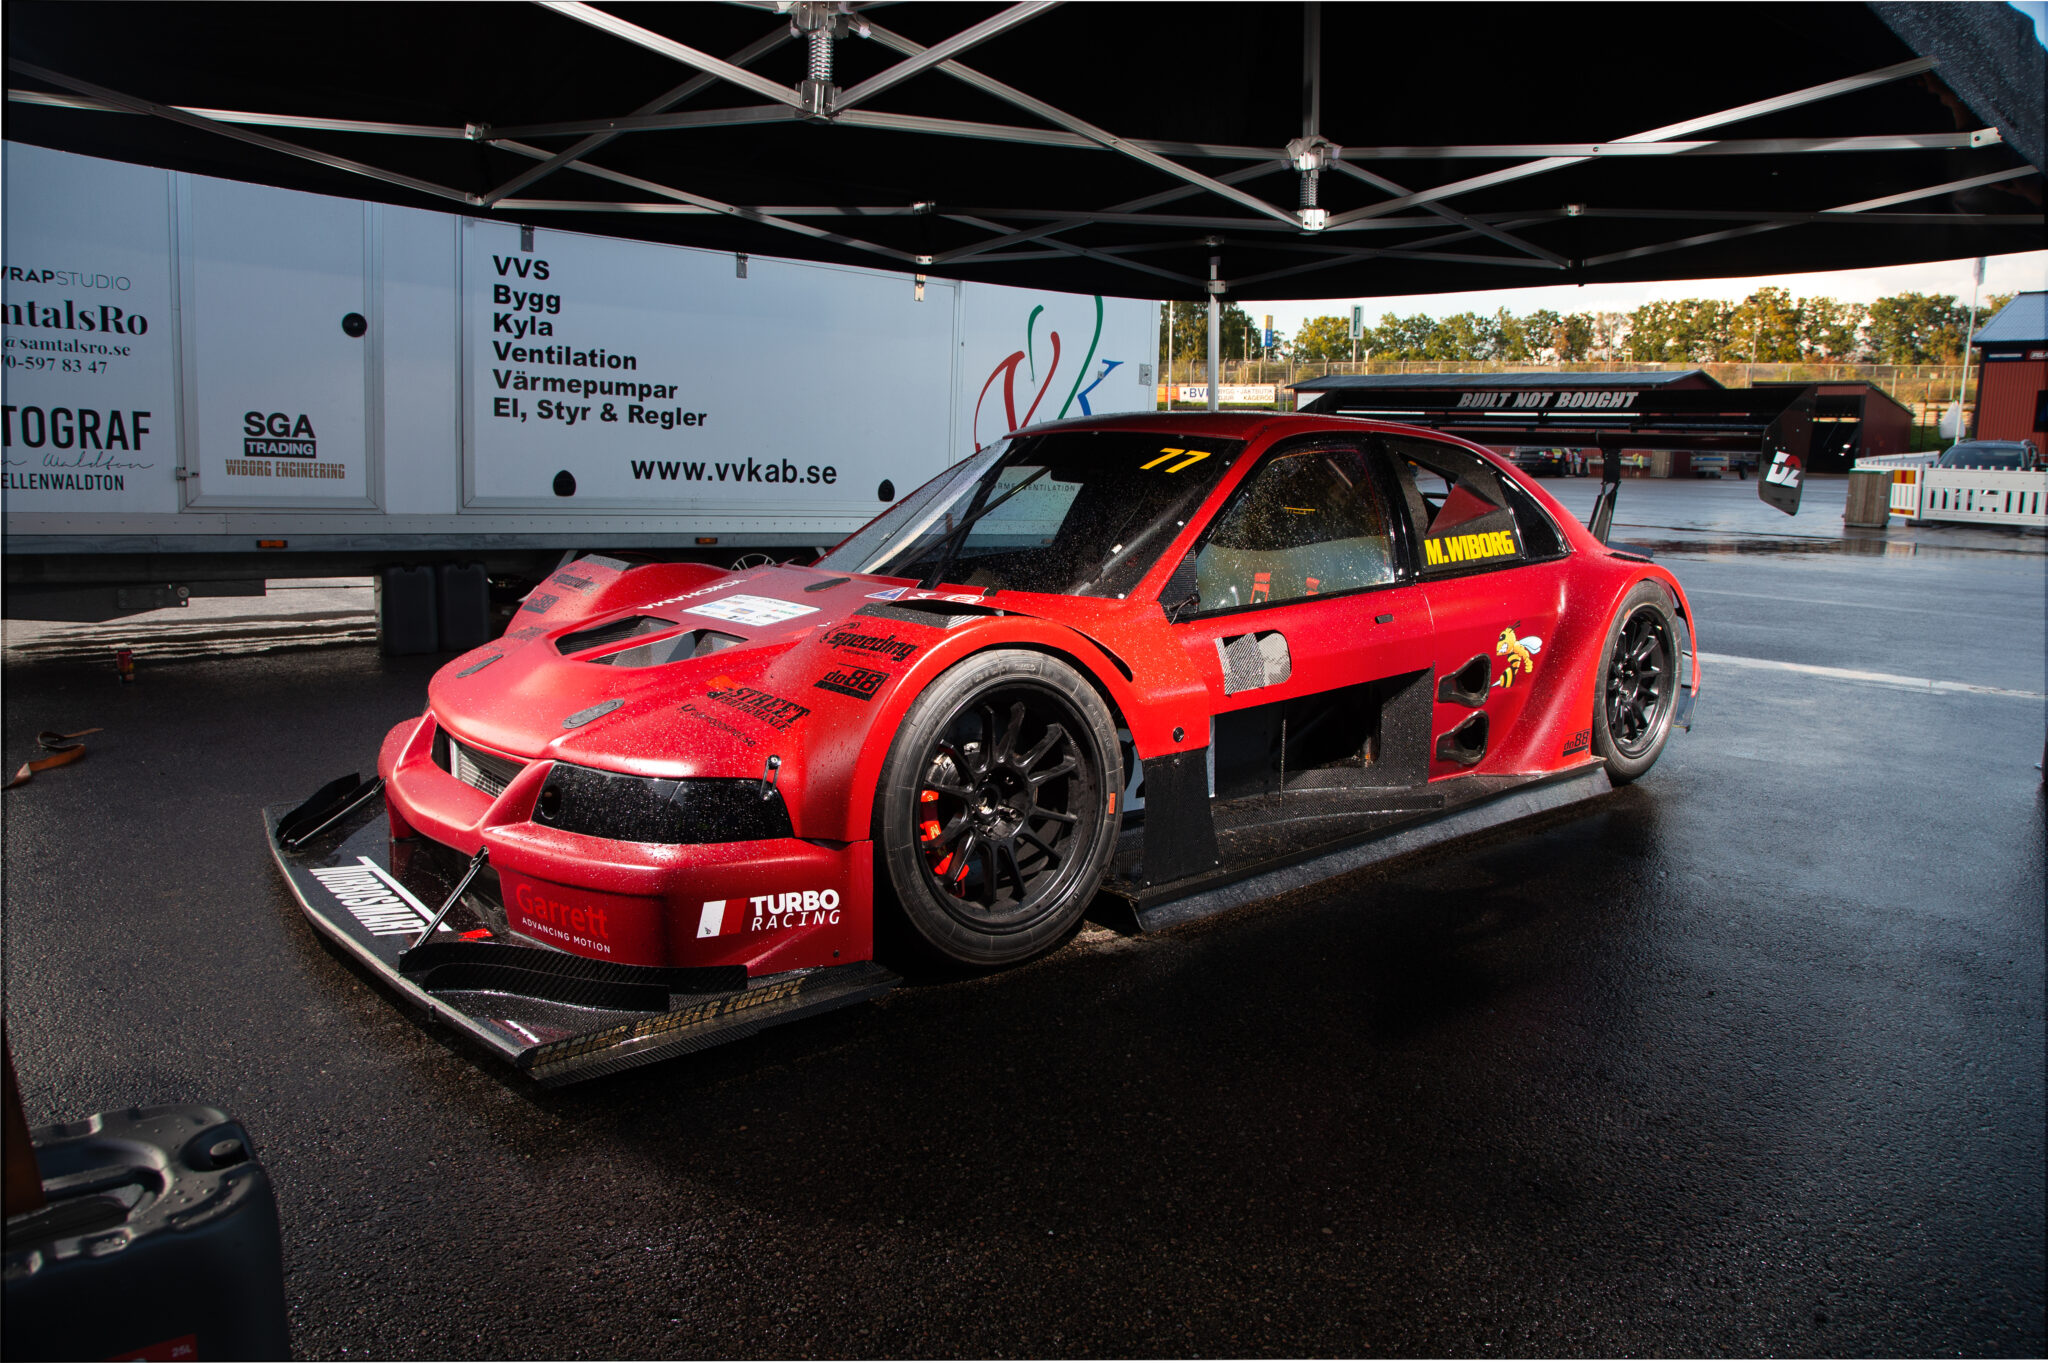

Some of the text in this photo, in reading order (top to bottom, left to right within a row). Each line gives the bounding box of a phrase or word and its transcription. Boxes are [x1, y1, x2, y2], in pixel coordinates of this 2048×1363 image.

[1, 266, 131, 291] RAPSTUDIO
[492, 255, 550, 280] VVS
[493, 284, 561, 314] Bygg
[493, 312, 553, 339] Kyla
[62, 359, 82, 373] 83
[88, 361, 108, 375] 47
[492, 340, 637, 370] Ventilation
[492, 368, 679, 401] Värmepumpar
[1456, 391, 1640, 408] BUILT NOT BOUGHT
[243, 411, 316, 438] SGA
[493, 397, 707, 430] El, Styr & Regler
[1, 405, 152, 450] TOGRAF
[246, 441, 314, 456] TRADING
[1139, 447, 1211, 473] 77
[225, 459, 345, 479] WIBORG ENGINEERING
[631, 457, 837, 484] www.vvkab.se
[1424, 530, 1516, 566] M.WIBORG
[827, 632, 919, 662] speeding
[822, 668, 885, 693] do88
[515, 883, 609, 939] Garrett
[749, 888, 840, 917] TURBO
[751, 909, 841, 932] RACING
[522, 916, 611, 954] ADVANCING MOTION
